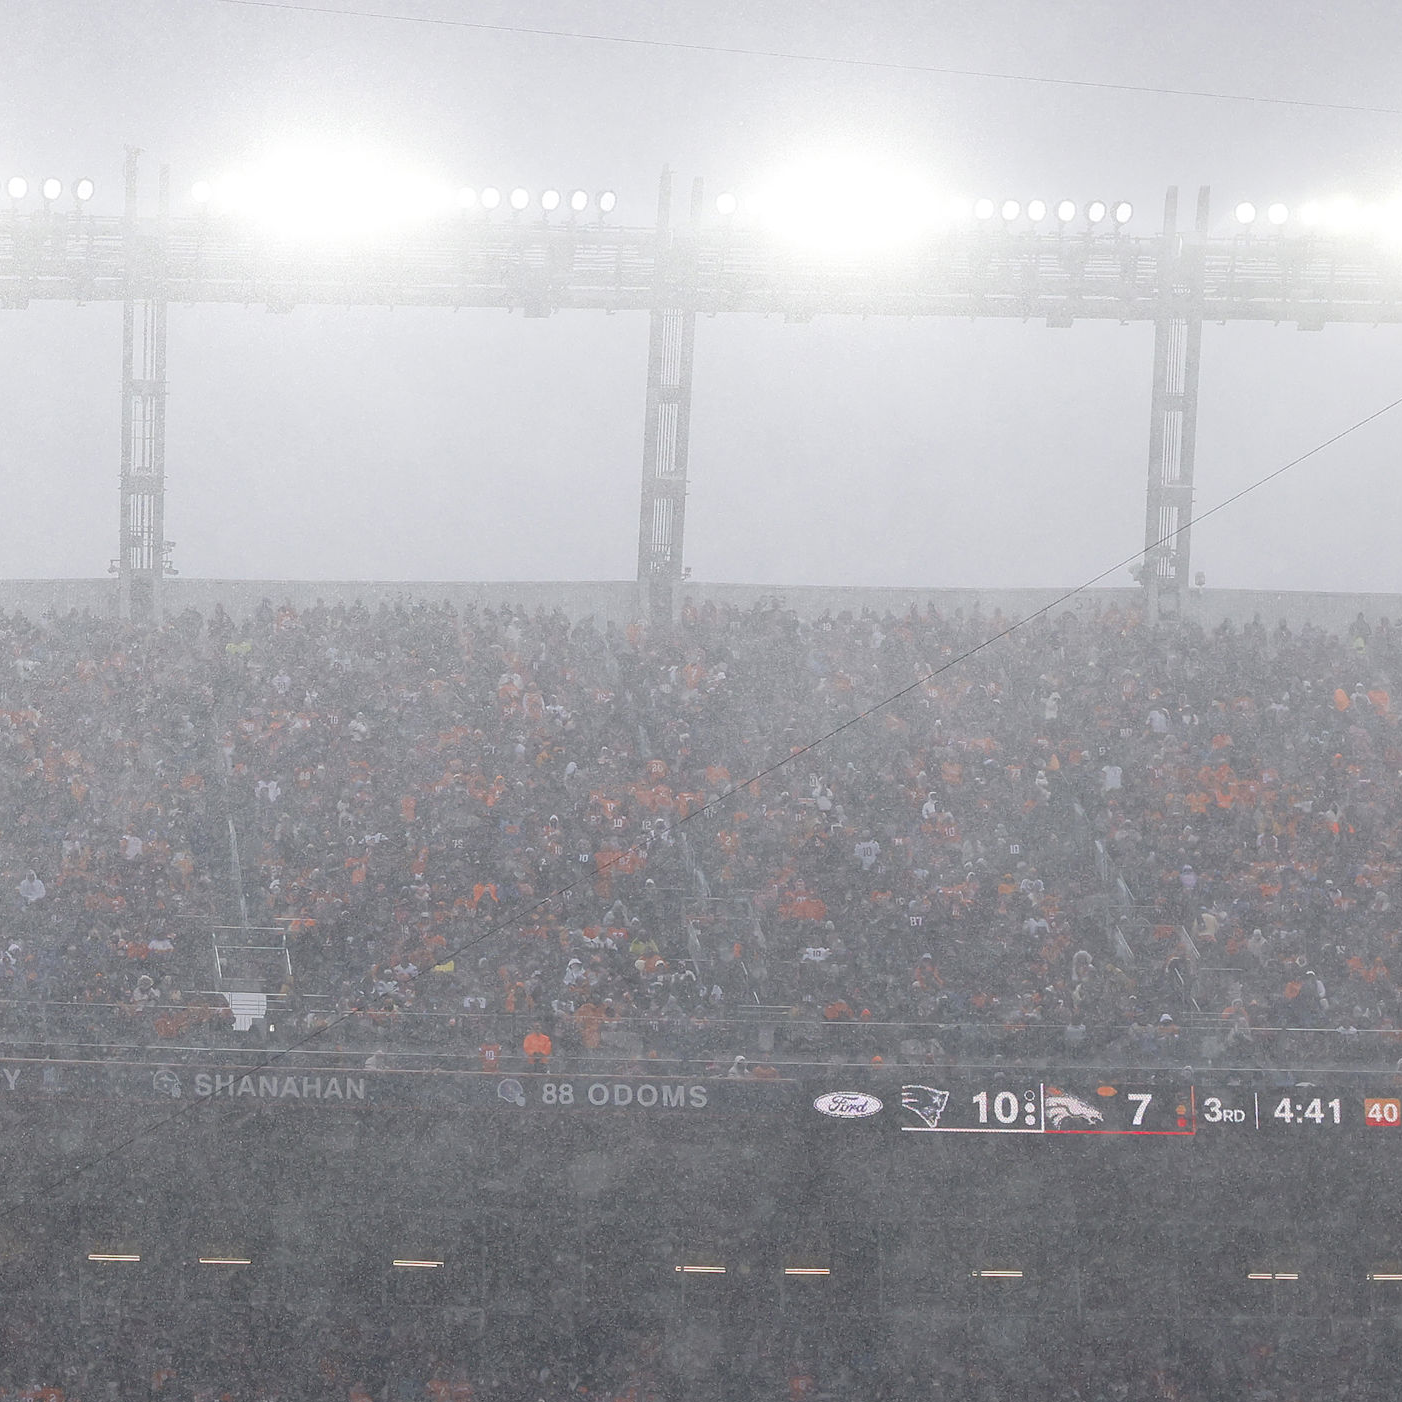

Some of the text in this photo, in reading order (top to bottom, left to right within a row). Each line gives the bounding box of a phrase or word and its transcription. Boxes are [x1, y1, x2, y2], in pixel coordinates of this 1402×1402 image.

[195, 1074, 366, 1100] SHANAHAN
[541, 1083, 709, 1109] 88 ODOMS
[828, 1095, 868, 1112] Ford
[972, 1092, 1020, 1124] 10
[1126, 1093, 1153, 1126] 7
[1203, 1097, 1341, 1124] 3RD 4:41
[1367, 1102, 1398, 1123] 40
